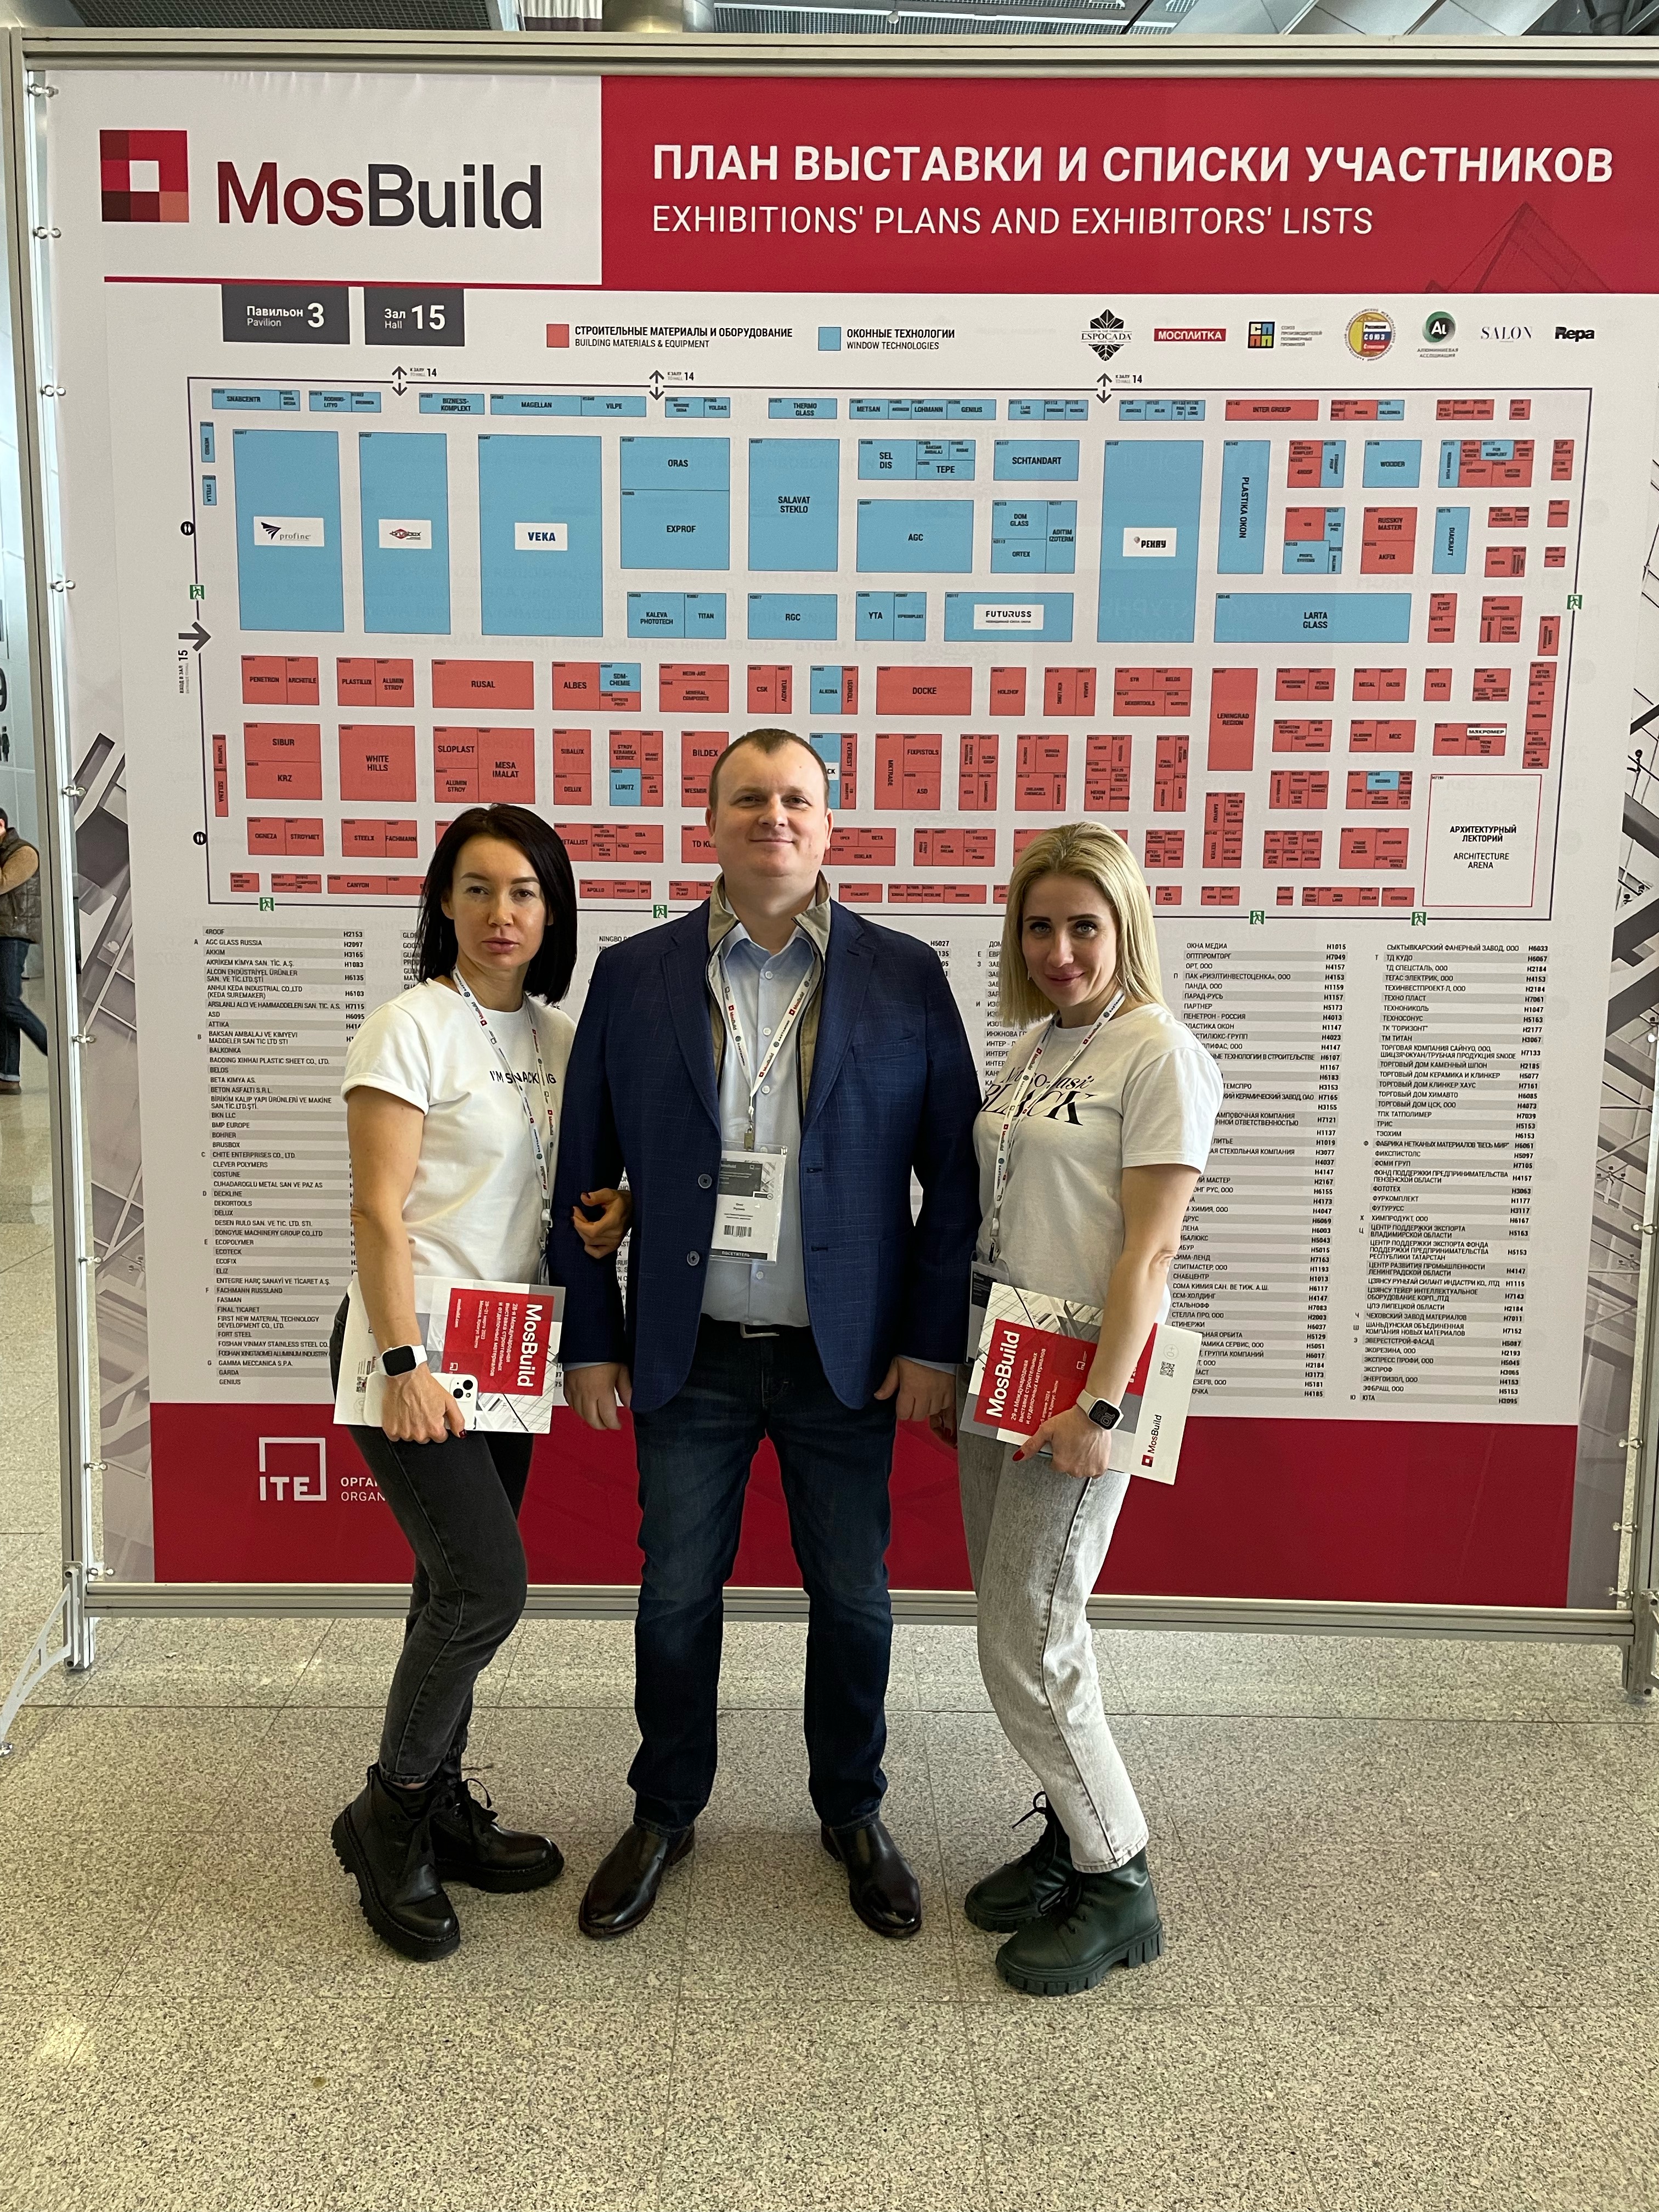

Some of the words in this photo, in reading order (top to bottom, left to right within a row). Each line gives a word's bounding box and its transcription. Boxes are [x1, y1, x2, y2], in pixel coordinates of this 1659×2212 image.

[652, 146, 780, 180] ПЛАН
[796, 146, 1041, 182] ВЫСТАВКИ
[1059, 147, 1084, 182] И
[1103, 147, 1289, 182] СПИСКИ
[1307, 148, 1613, 182] УЧАСТНИКОВ
[217, 161, 542, 229] MosBuild
[652, 205, 863, 233] EXHIBITIONS'
[875, 206, 981, 234] PLANS
[993, 206, 1060, 234] AND
[1072, 206, 1272, 235] EXHIBITORS'
[1285, 207, 1373, 235] LISTS
[246, 305, 303, 317] Павильон
[308, 303, 324, 328] 3
[385, 308, 405, 319] Зал
[411, 305, 445, 330] 15
[247, 317, 281, 327] Pavilion
[385, 320, 402, 329] Hall
[575, 326, 648, 337] СТРОИТЕЛЬНЫЕ
[651, 326, 708, 337] МАТЕРИАЛЫ
[710, 328, 716, 337] И
[719, 328, 792, 340] ОБОРУДОВАНИЕ
[848, 329, 891, 338] ОКОННЫЕ
[894, 330, 955, 340] ТЕХНОЛОГИИ
[1158, 331, 1222, 340] МОСПЛИТКА
[1481, 327, 1532, 340] SALON
[575, 339, 611, 347] BUILDING
[882, 342, 939, 350] TECHNOLOGIES
[427, 368, 437, 377] 14
[685, 372, 694, 381] 14
[1132, 375, 1142, 383] 14
[1240, 477, 1249, 515] PLASTIKA
[667, 525, 696, 533] EXPROF
[528, 532, 556, 541] VEKA
[178, 650, 188, 661] 15
[692, 749, 718, 757] BILDEX
[1450, 825, 1516, 833] АРХИТЕКТУРНЫЙ
[1462, 833, 1503, 842] ЛЕКТОРИЙ
[517, 1304, 543, 1387] MosBuild
[986, 1330, 1020, 1418] MosBuild
[1147, 1415, 1161, 1454] MosBuild
[259, 1476, 311, 1501] ITE
